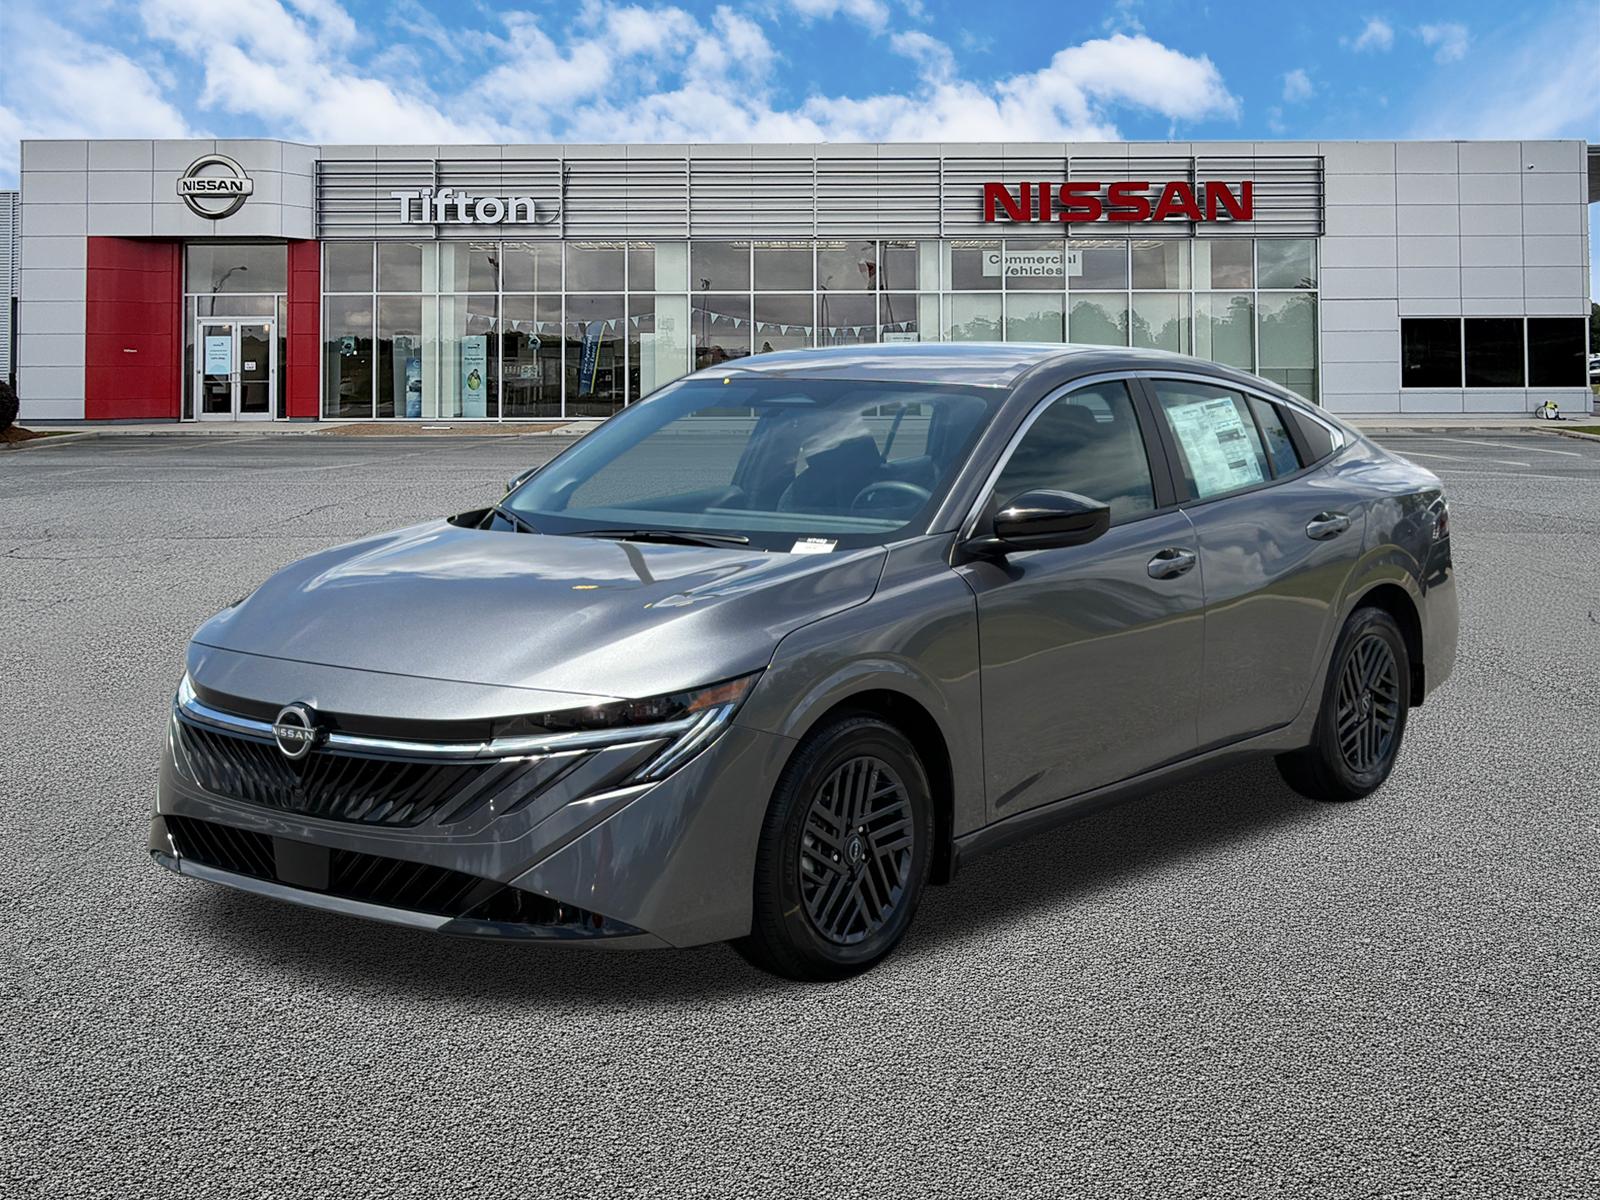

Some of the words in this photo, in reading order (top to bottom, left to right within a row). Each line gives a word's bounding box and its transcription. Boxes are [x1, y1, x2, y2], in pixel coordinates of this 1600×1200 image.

[182, 180, 243, 191] NISSAN
[390, 187, 536, 224] Tifton
[983, 180, 1253, 223] NISSAN
[271, 726, 314, 741] NISSAN
